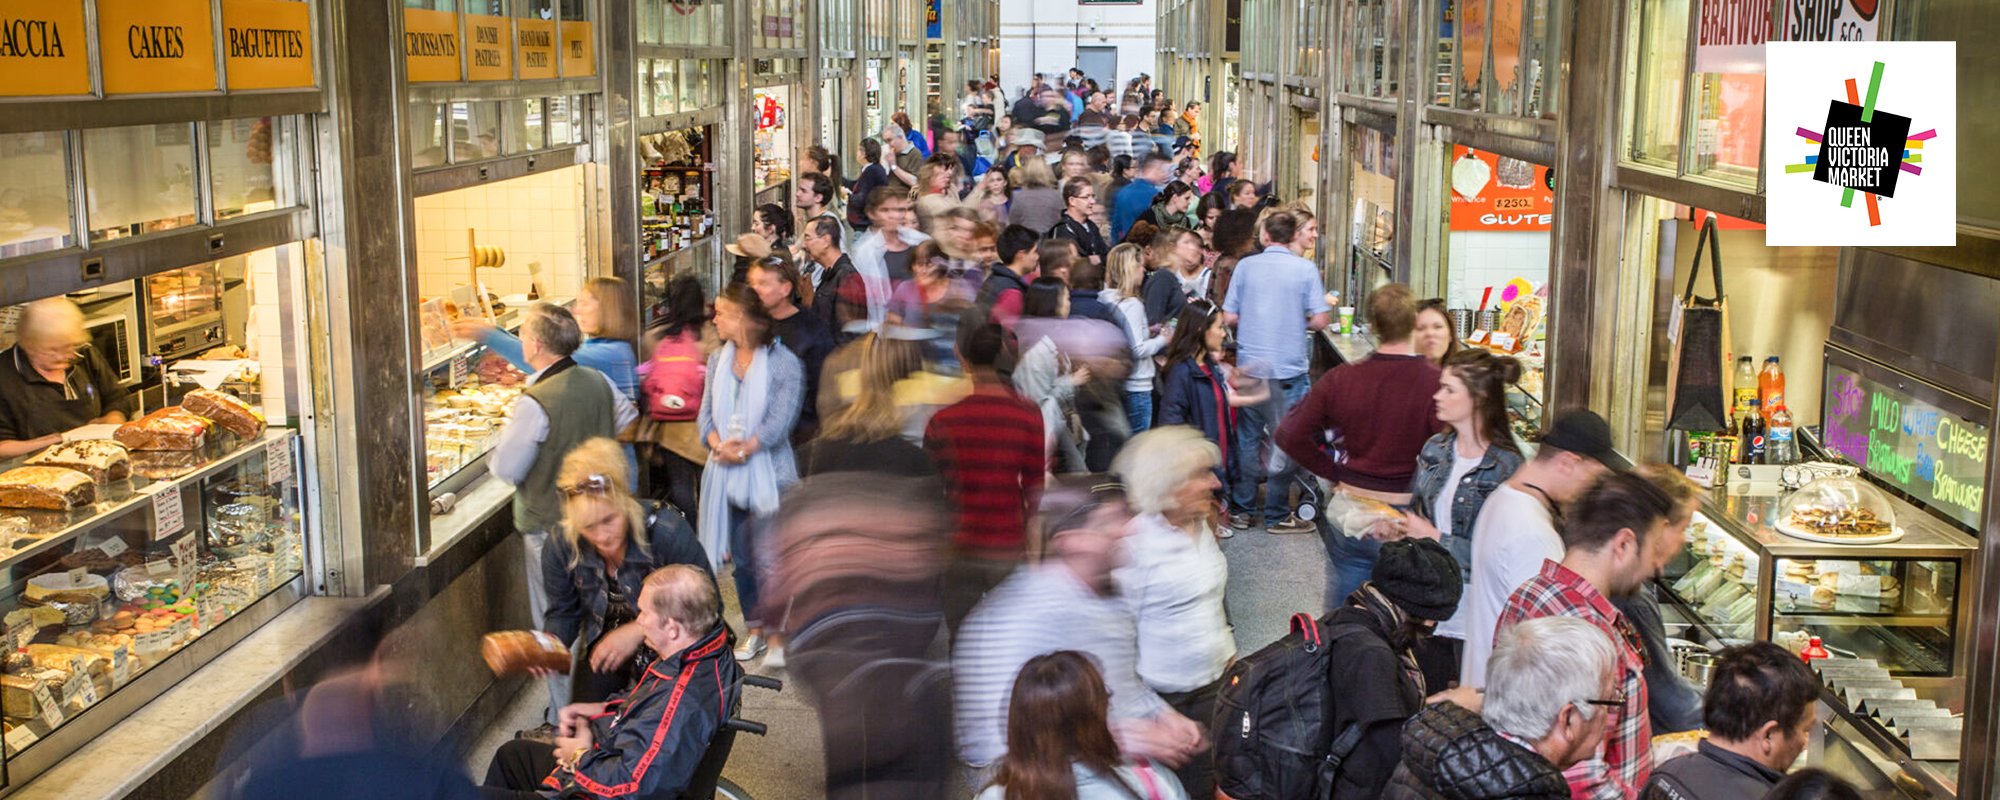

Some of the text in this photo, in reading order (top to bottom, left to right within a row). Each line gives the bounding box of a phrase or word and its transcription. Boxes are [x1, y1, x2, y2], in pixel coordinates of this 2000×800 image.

[476, 26, 498, 44] DANISH
[1791, 0, 1843, 42] SHOP
[0, 18, 65, 58] ACCIA
[128, 25, 185, 59] CAKES
[229, 27, 303, 58] BAGUETTES
[405, 32, 455, 57] CROISSANTS
[475, 49, 501, 67] PASTRIES
[526, 52, 548, 68] PASTRIES
[1869, 391, 1899, 433] MILD
[1903, 406, 1938, 437] WHITE
[1936, 417, 1988, 463] CHEESE
[1932, 459, 1985, 513] BRATWURST
